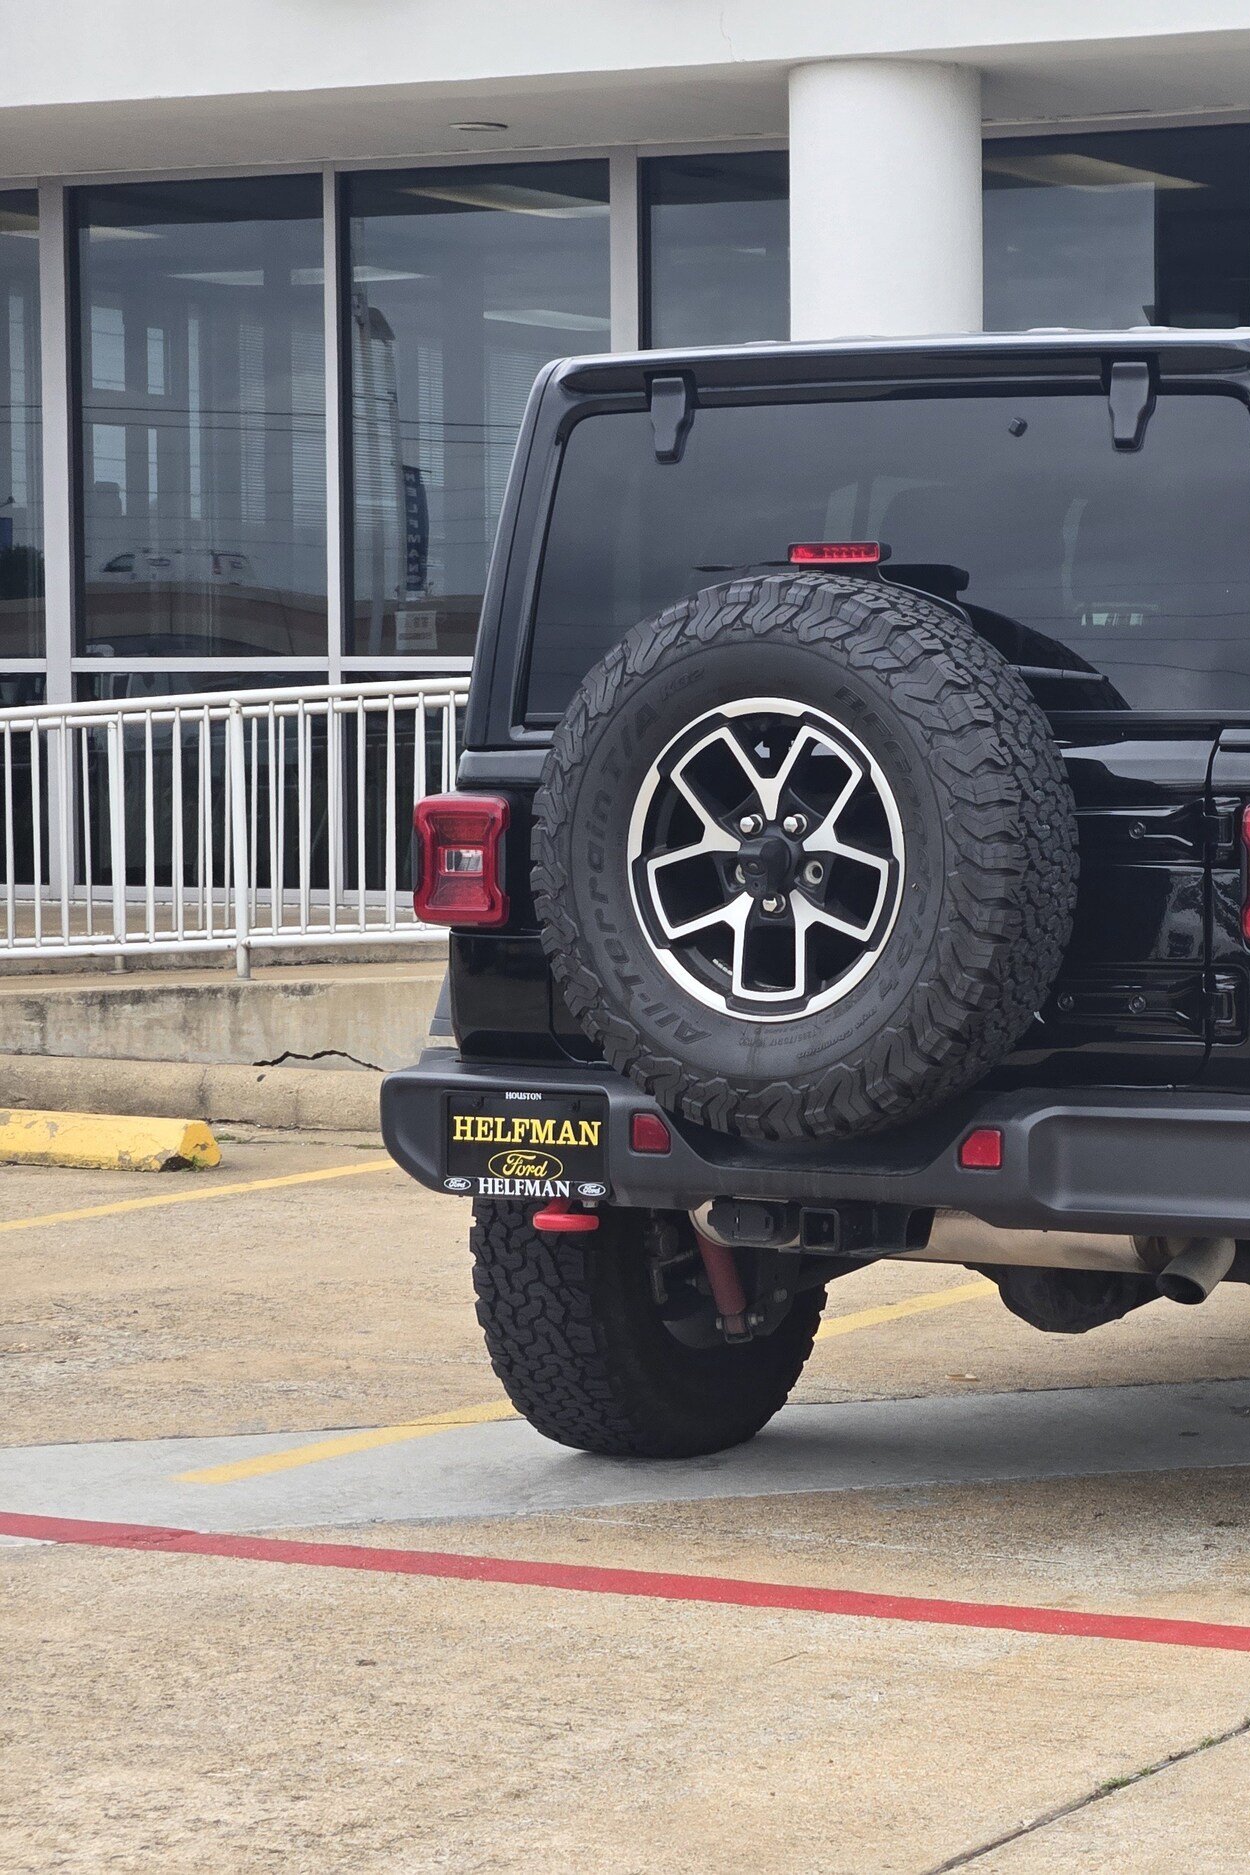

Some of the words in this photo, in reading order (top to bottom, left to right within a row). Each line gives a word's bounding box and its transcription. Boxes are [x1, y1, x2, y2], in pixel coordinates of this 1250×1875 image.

[505, 1092, 542, 1100] HOUSTON
[453, 1115, 602, 1146] HELFMAN
[502, 1153, 549, 1178] Ford
[448, 1179, 467, 1189] Ford
[478, 1177, 570, 1197] HELFMAN
[582, 1185, 601, 1195] Ford
